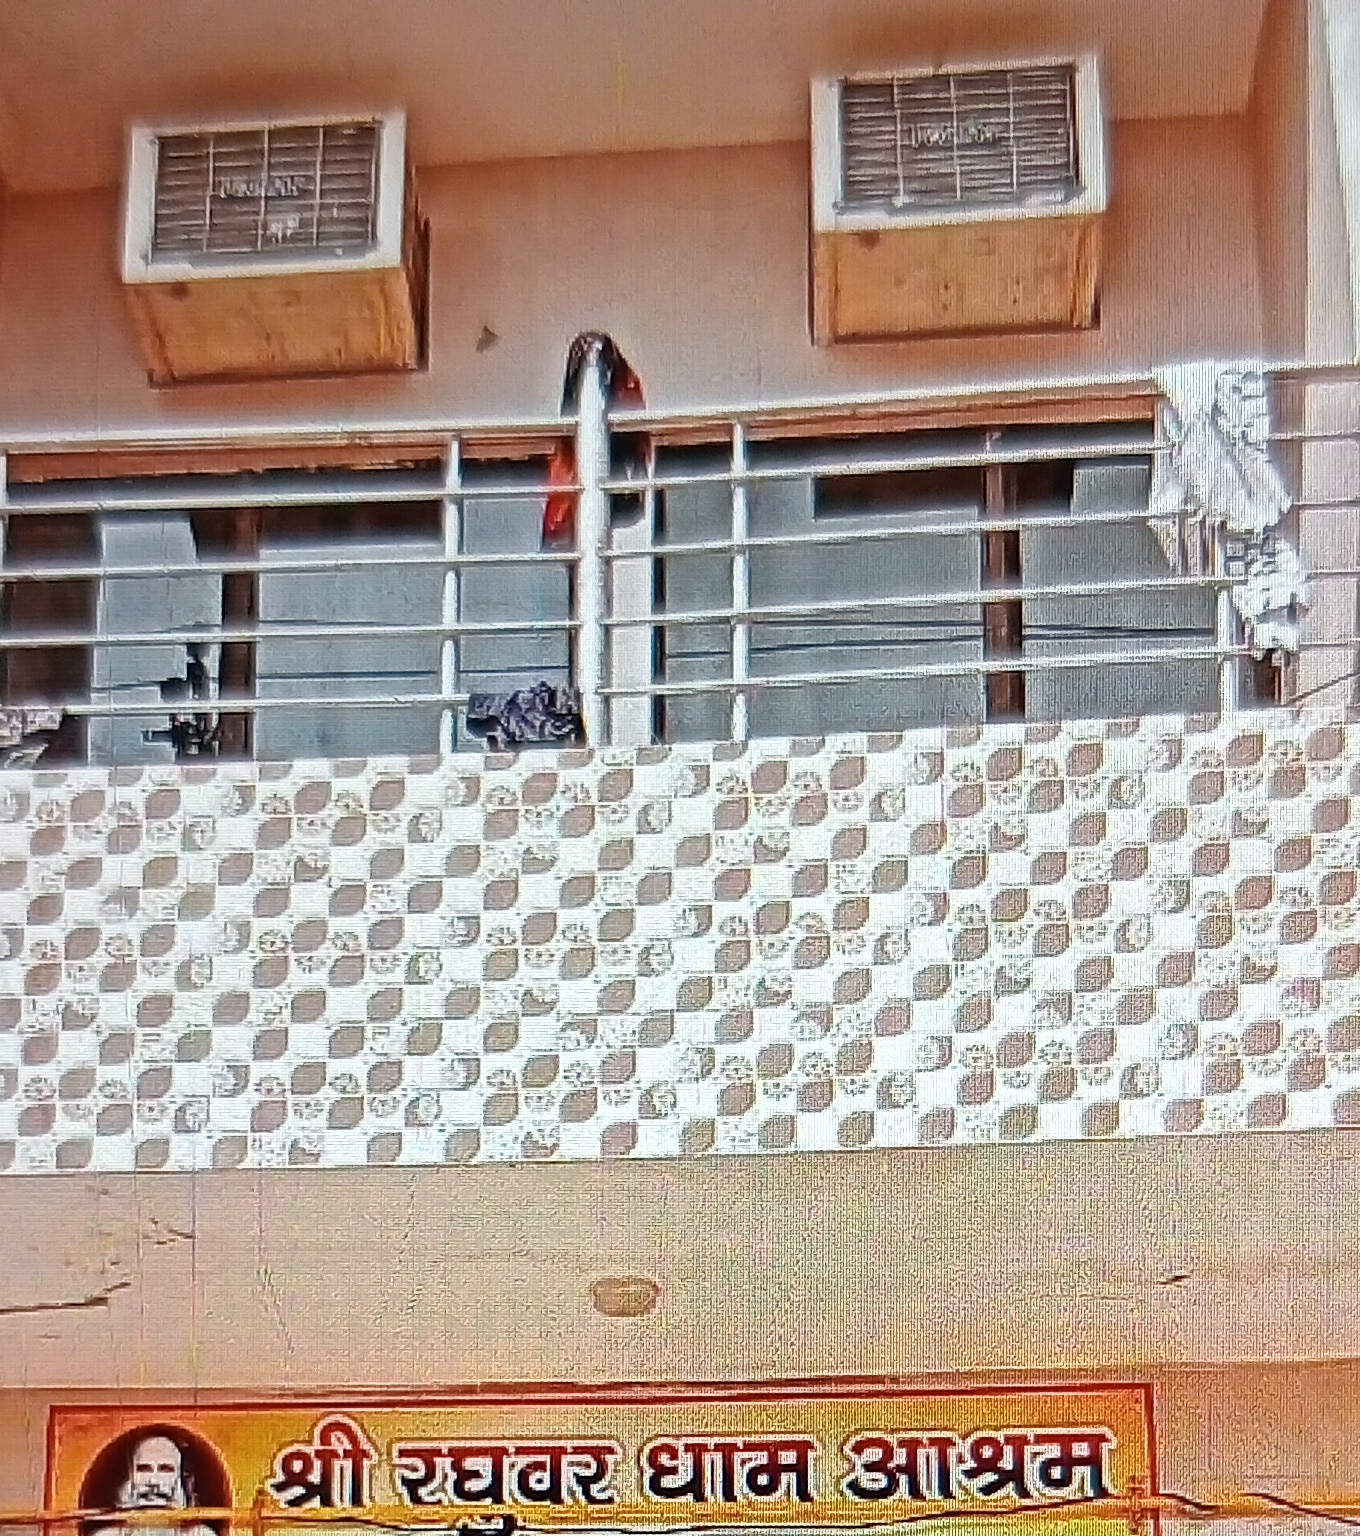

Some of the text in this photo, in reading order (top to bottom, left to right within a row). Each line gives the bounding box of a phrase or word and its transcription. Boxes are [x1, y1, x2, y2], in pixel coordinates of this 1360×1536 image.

[269, 1418, 373, 1508] श्री
[646, 1437, 815, 1502] धाम
[844, 1432, 1110, 1500] आश्रम
